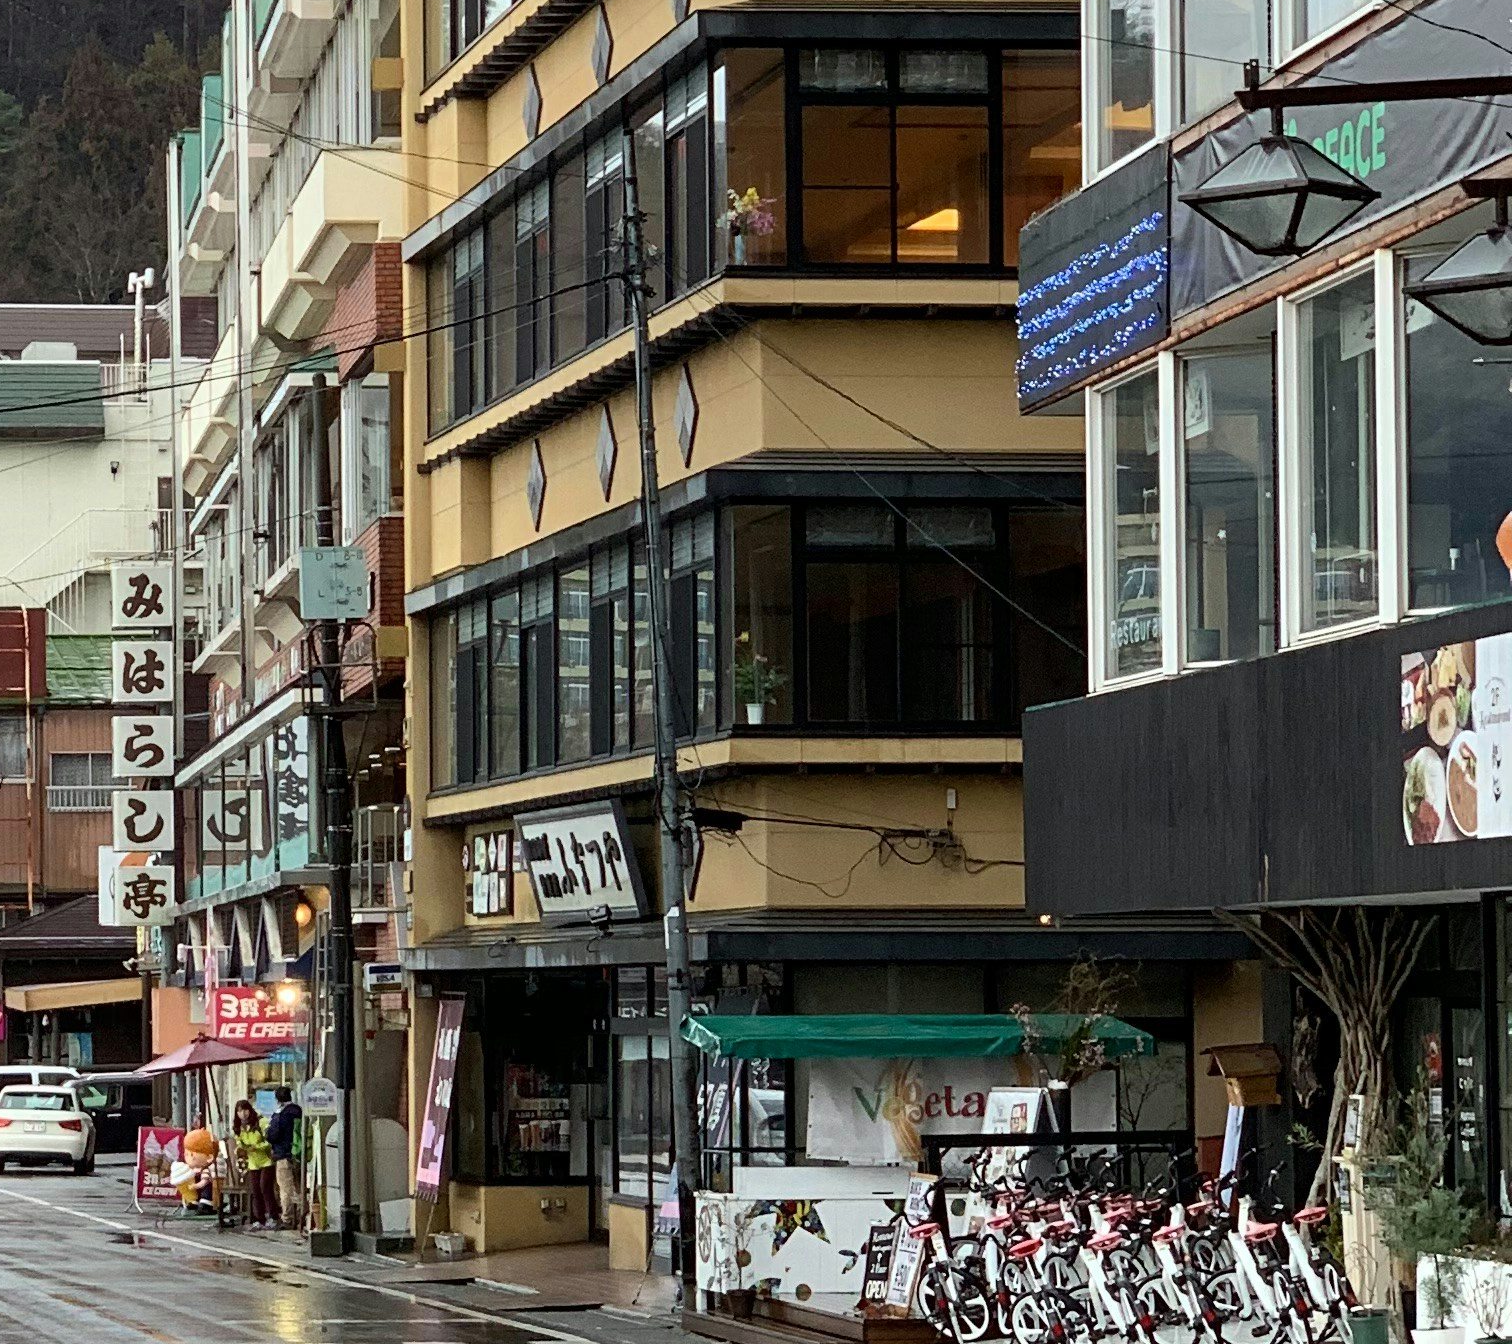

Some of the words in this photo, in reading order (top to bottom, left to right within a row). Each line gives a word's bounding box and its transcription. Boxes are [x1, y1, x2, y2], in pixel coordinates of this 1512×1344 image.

[121, 572, 168, 920] みはらし亭
[218, 1021, 249, 1039] ICE
[865, 1279, 888, 1299] OPEN
